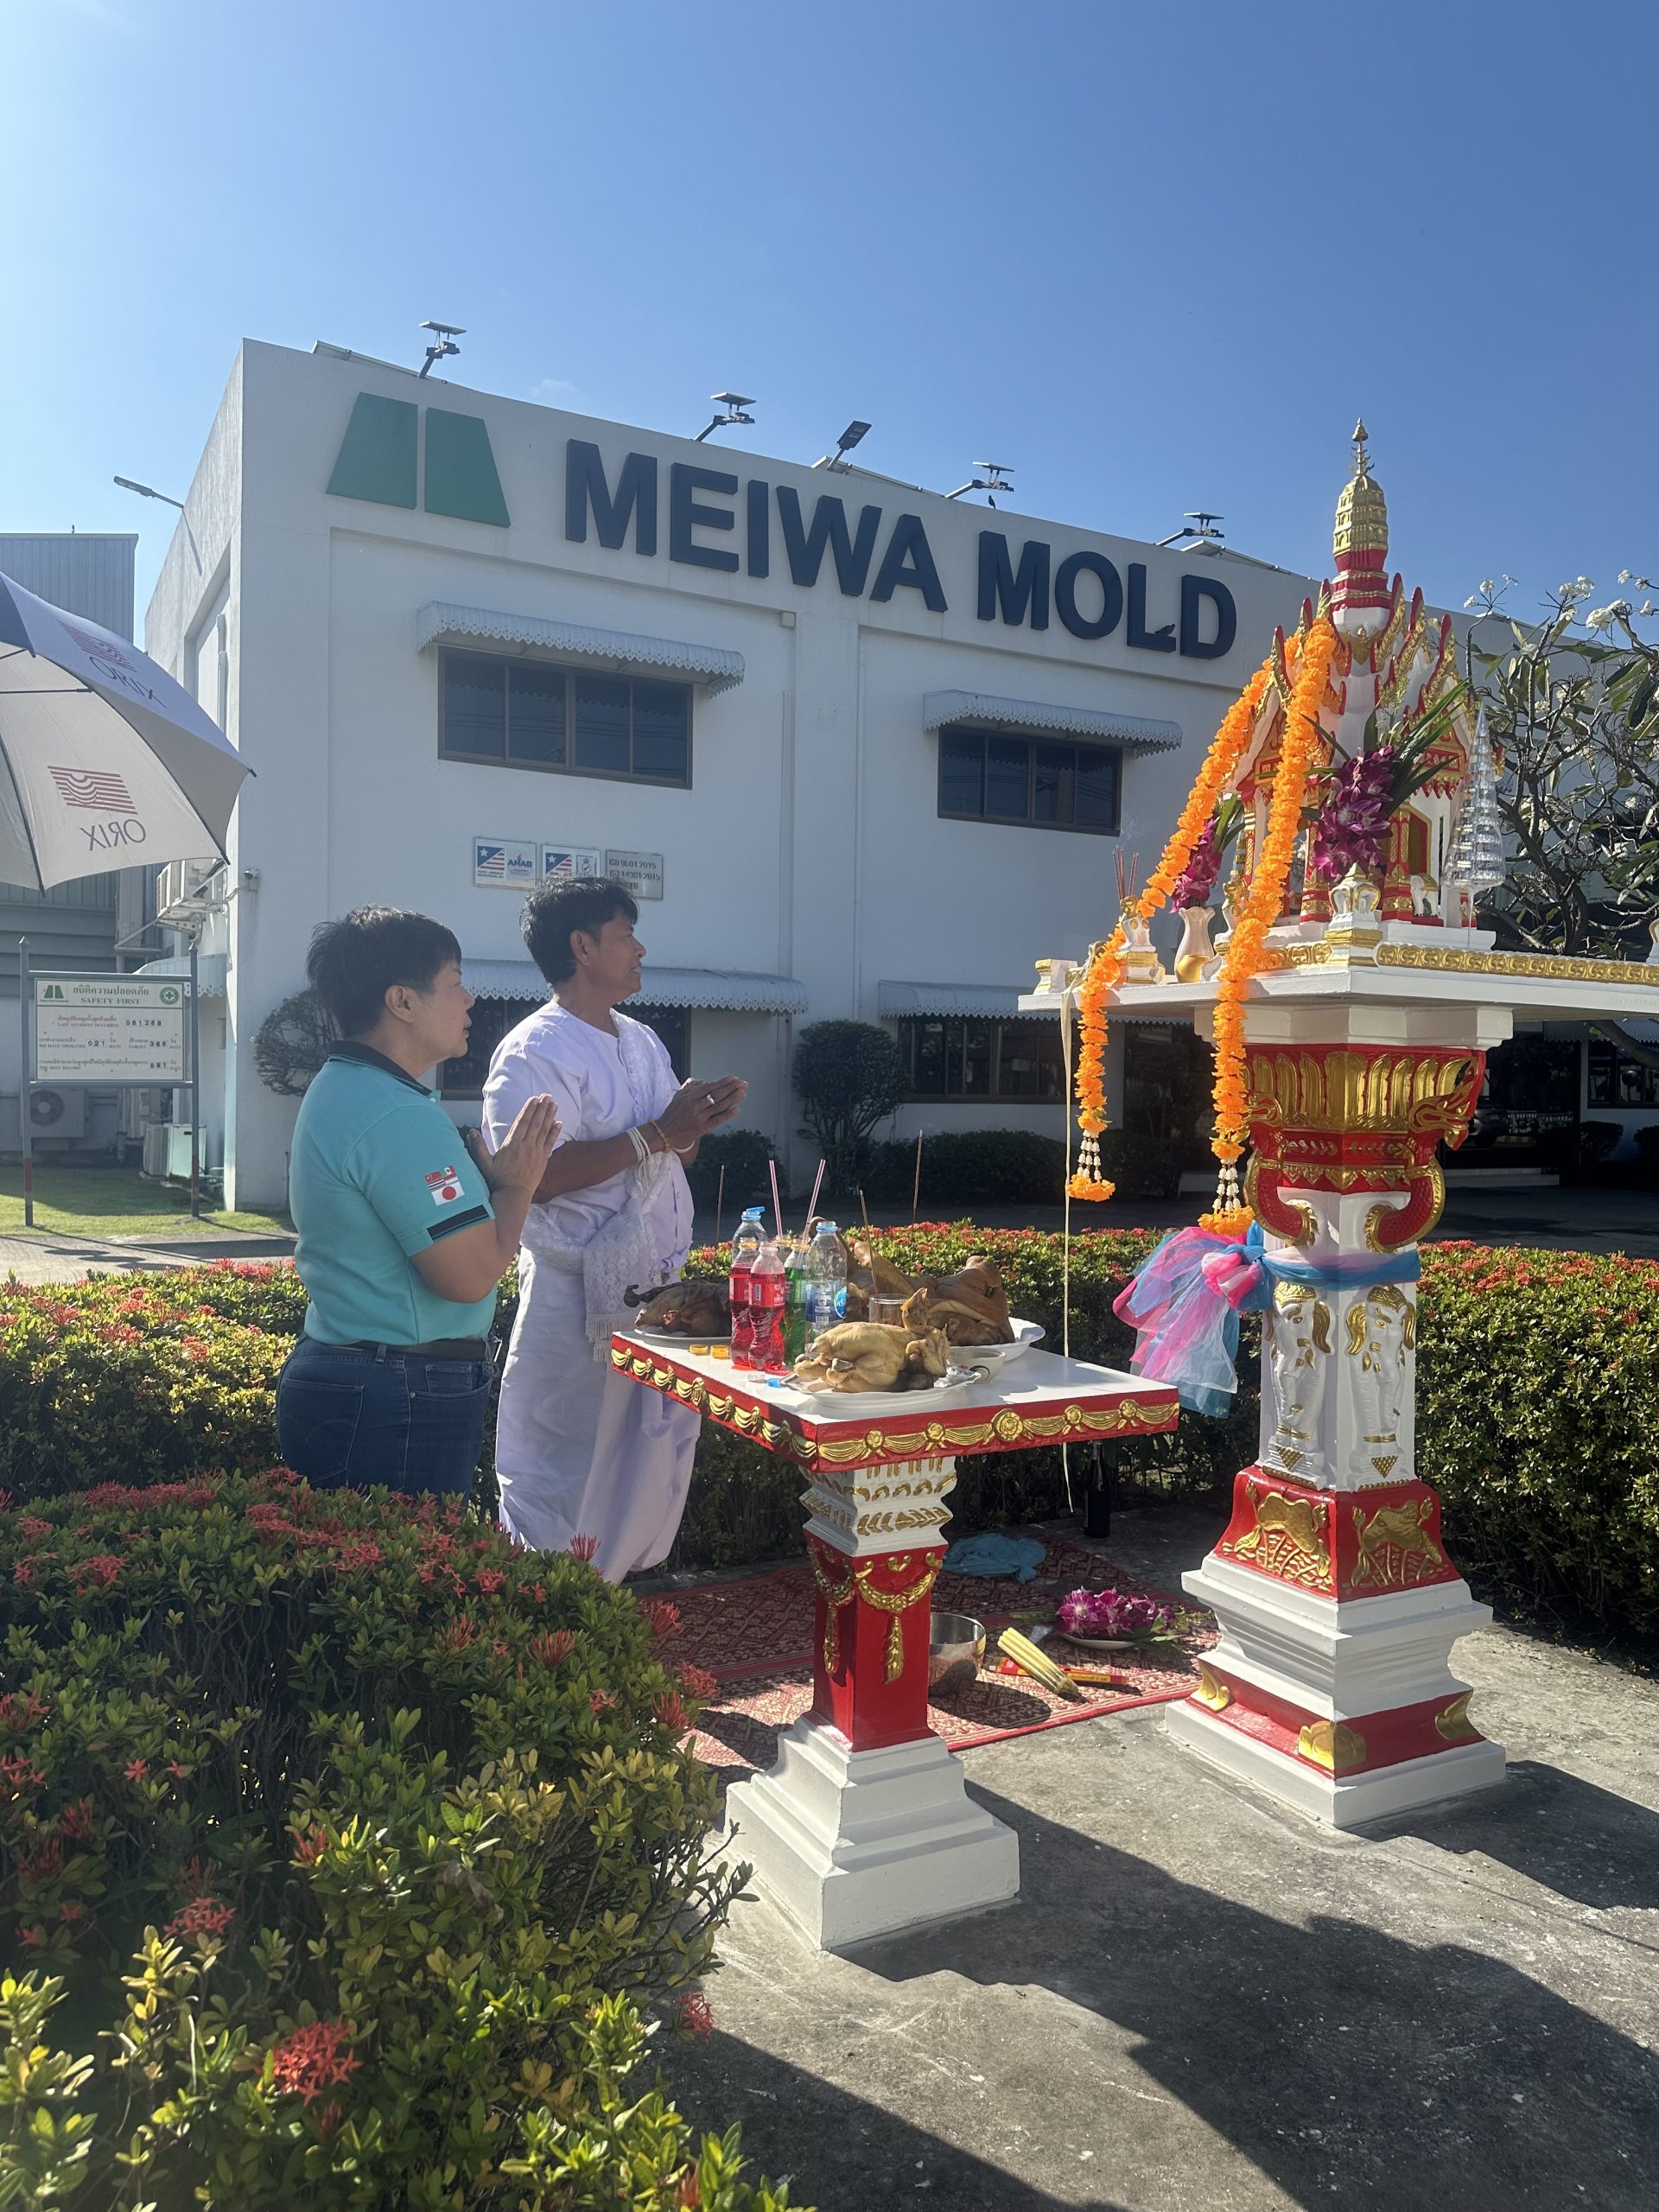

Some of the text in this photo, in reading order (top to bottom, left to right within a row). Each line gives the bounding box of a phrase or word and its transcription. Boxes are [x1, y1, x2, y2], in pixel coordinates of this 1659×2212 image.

[564, 438, 1237, 659] MEIWA MOLD
[89, 656, 167, 709] ORIX
[507, 858, 533, 868] ANAB
[73, 984, 149, 995] สถิติความปลอดภัย
